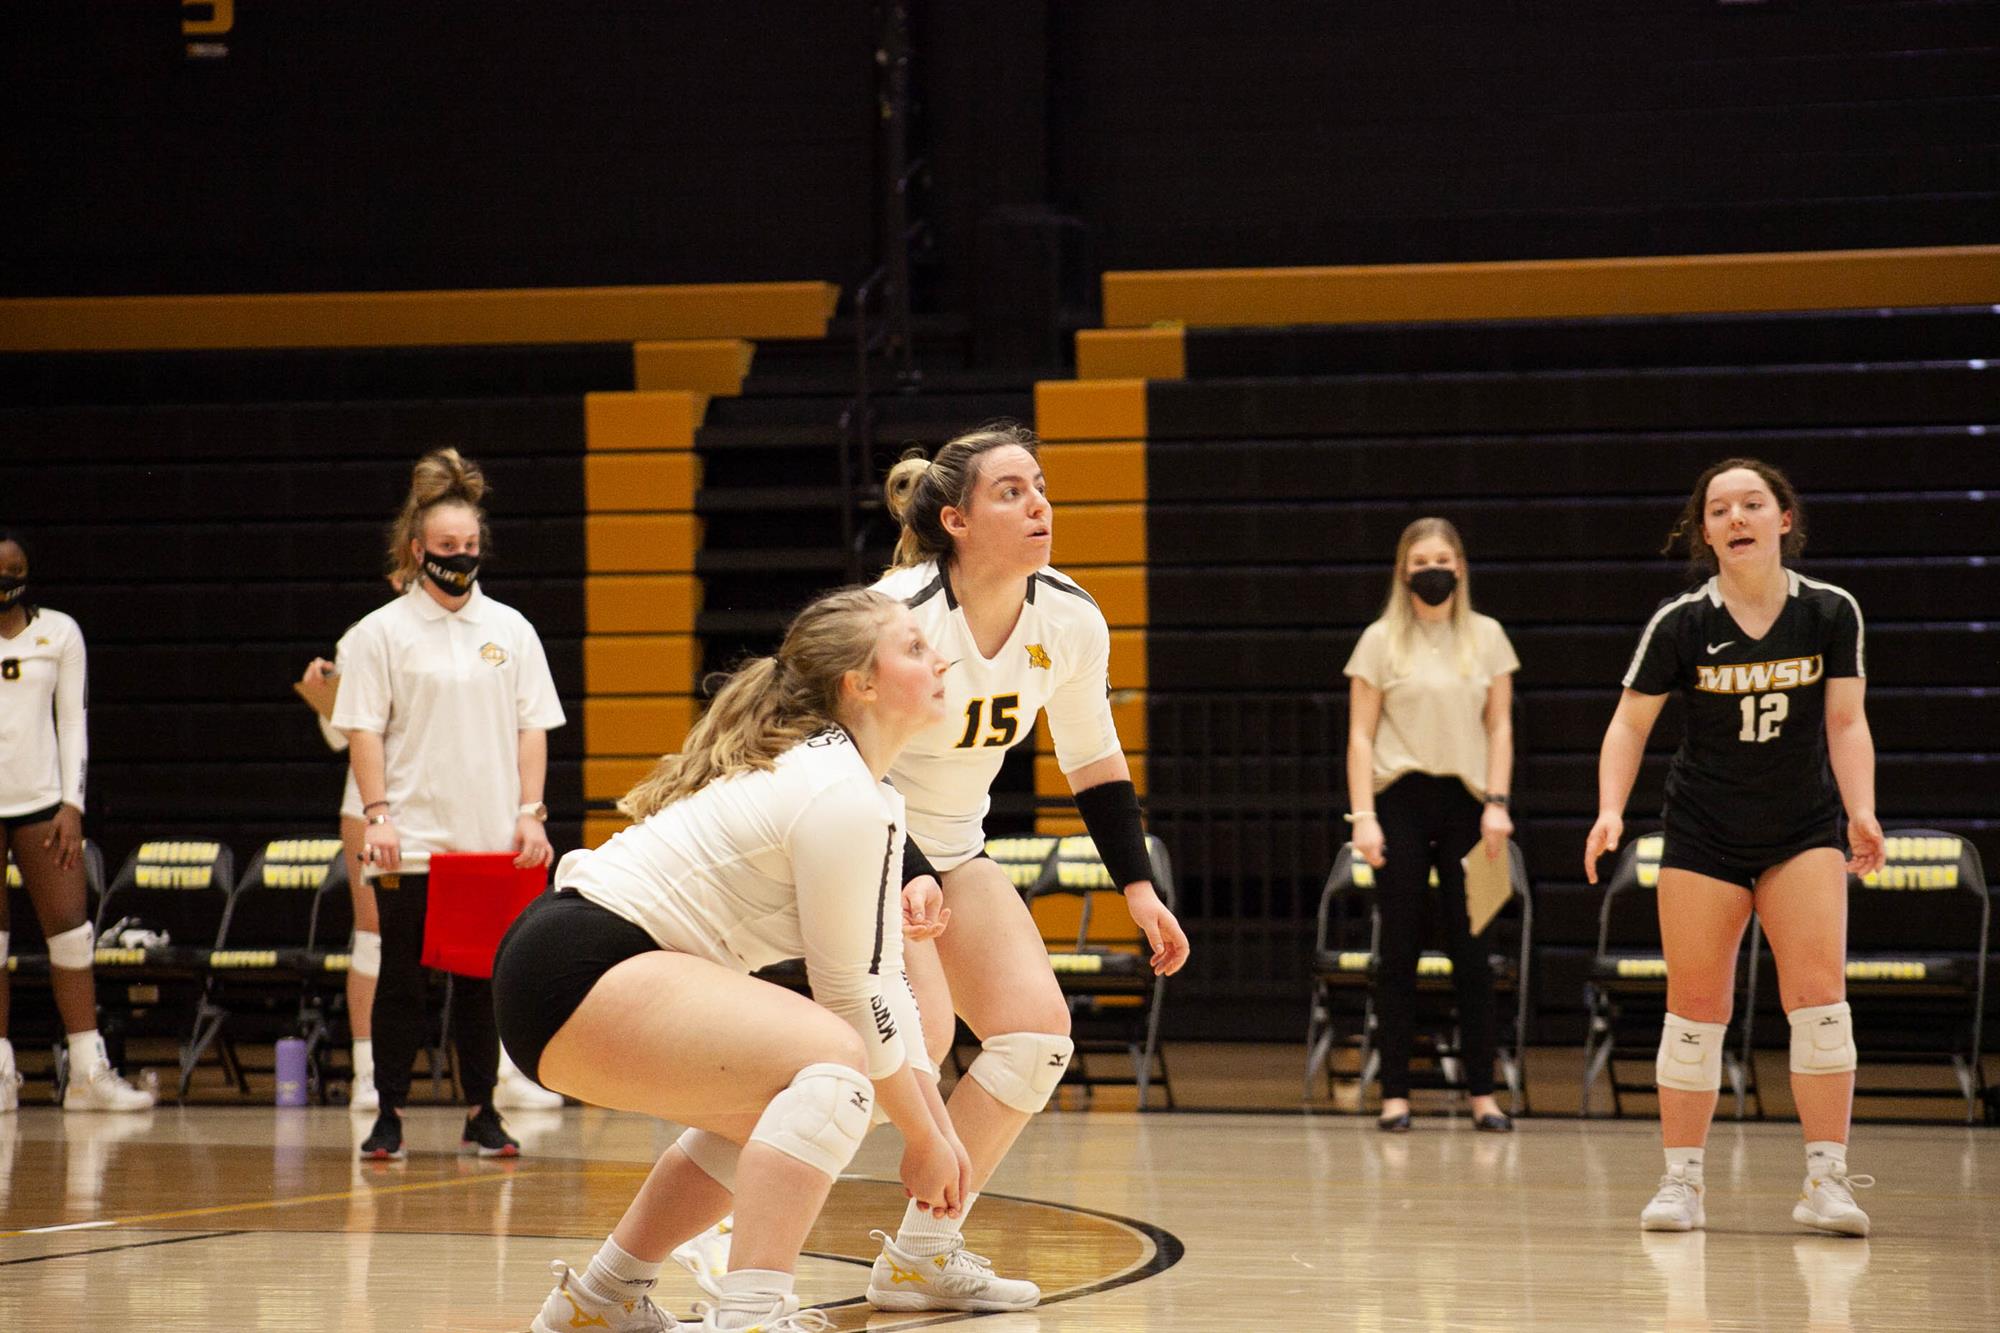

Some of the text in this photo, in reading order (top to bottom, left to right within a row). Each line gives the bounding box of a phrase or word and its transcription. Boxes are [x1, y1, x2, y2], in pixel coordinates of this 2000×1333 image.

[1695, 653, 1824, 694] MWSU
[954, 691, 1020, 750] 15
[1739, 691, 1789, 743] 12
